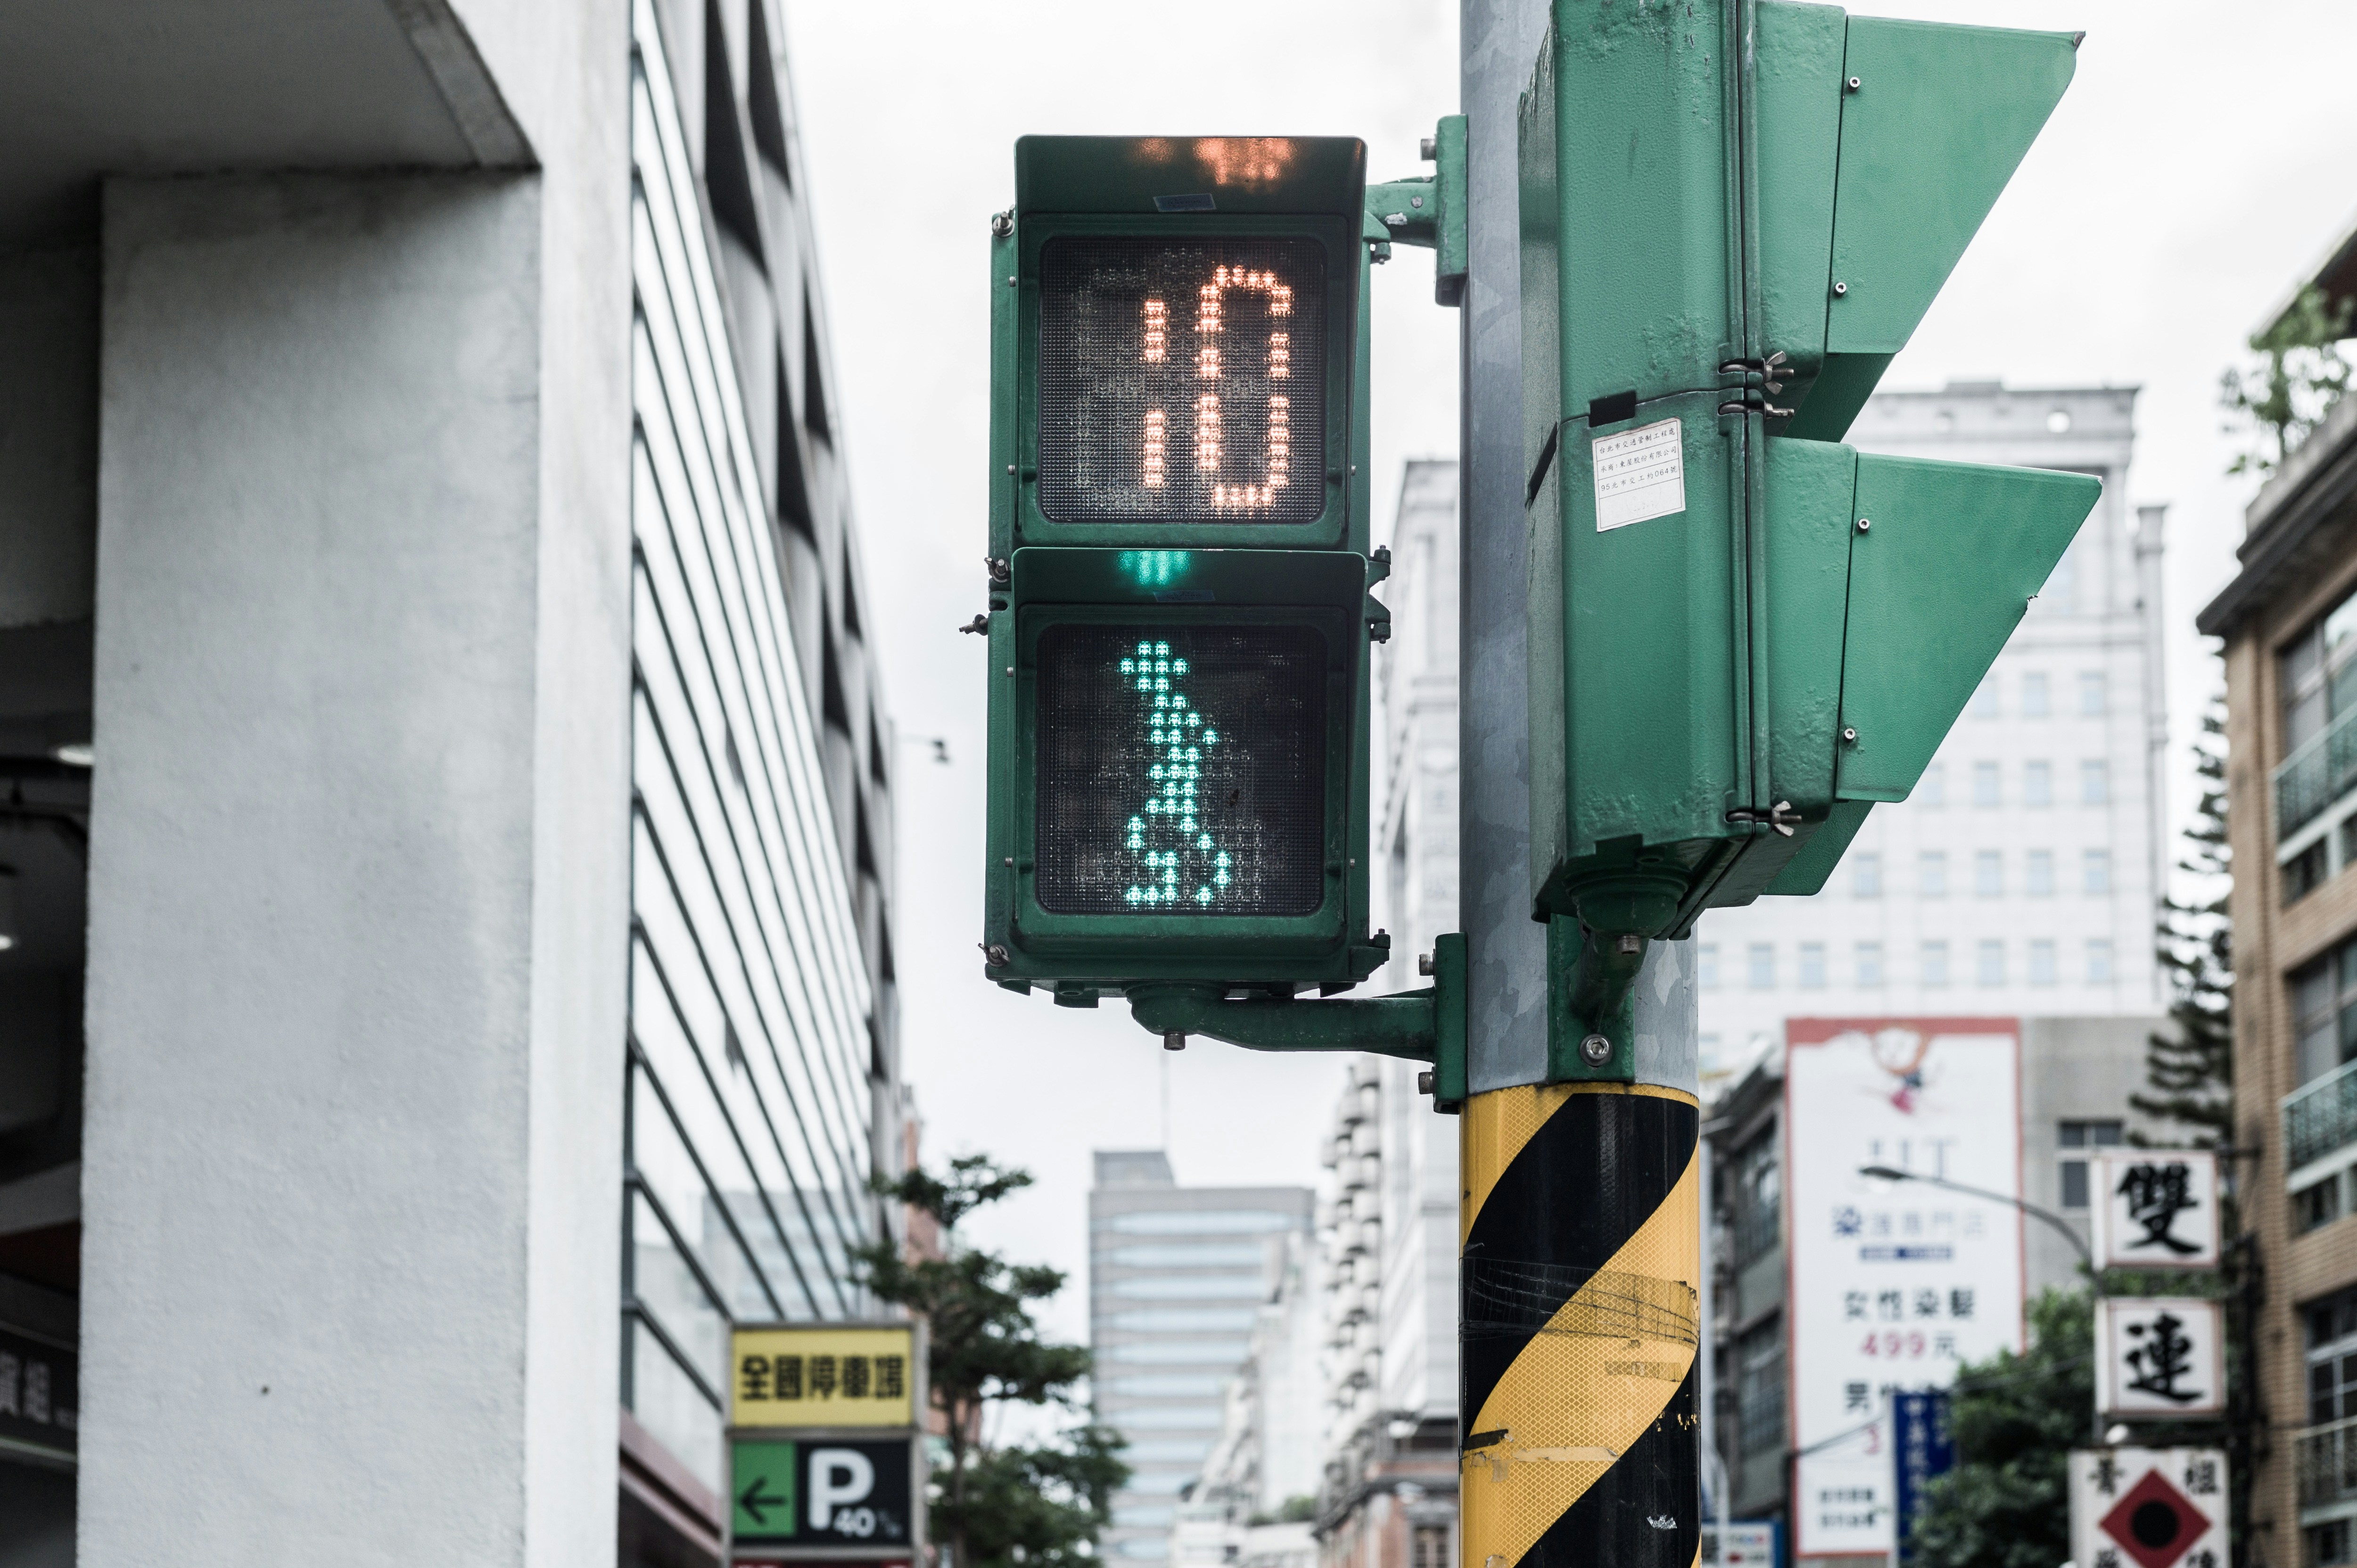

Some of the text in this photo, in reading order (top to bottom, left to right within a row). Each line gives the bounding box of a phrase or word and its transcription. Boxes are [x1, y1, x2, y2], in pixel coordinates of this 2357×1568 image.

[1143, 265, 1293, 510] 10
[1599, 427, 1675, 454] 台北市交通管制工程處
[741, 1355, 905, 1402] 全國停車場
[807, 1448, 876, 1531] P
